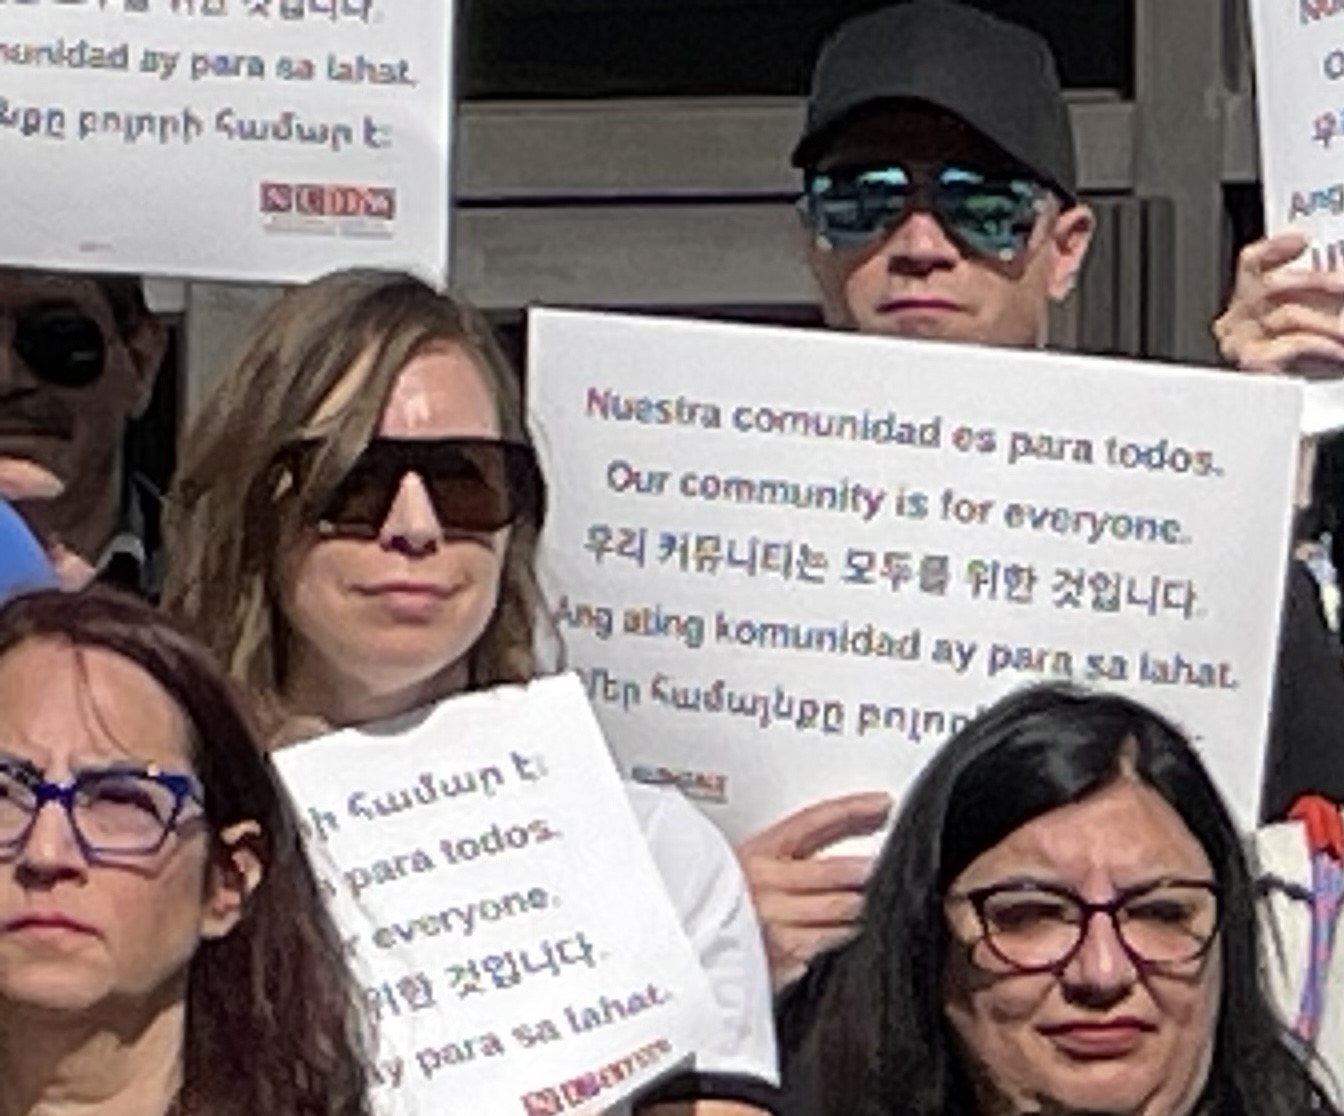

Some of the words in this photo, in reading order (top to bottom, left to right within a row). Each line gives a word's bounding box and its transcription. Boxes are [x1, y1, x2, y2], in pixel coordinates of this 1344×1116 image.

[190, 52, 266, 82] para
[586, 386, 722, 430] Nuestra
[731, 406, 943, 449] comunidad
[951, 425, 998, 454] es
[1007, 431, 1095, 466] para
[1104, 436, 1224, 477] todos.
[606, 459, 672, 495] Our
[678, 471, 888, 523] community
[895, 486, 929, 521] is
[940, 488, 996, 525] for
[1003, 502, 1191, 545] everyone.
[583, 524, 648, 569] 우리
[657, 531, 829, 585] 커뮤니티는
[839, 547, 951, 597] 모두를
[964, 558, 1039, 605] 위한
[622, 604, 706, 650] ating
[715, 610, 922, 661] komunidad
[930, 638, 979, 675] ay
[988, 642, 1073, 679] para
[1085, 654, 1129, 682] sa
[1139, 651, 1239, 690] lahat.
[342, 848, 437, 903] para
[439, 819, 563, 865] todos.
[371, 887, 563, 950] everyone.
[415, 1032, 506, 1081] para
[511, 1019, 562, 1049] sa
[563, 983, 672, 1034] lahat.
